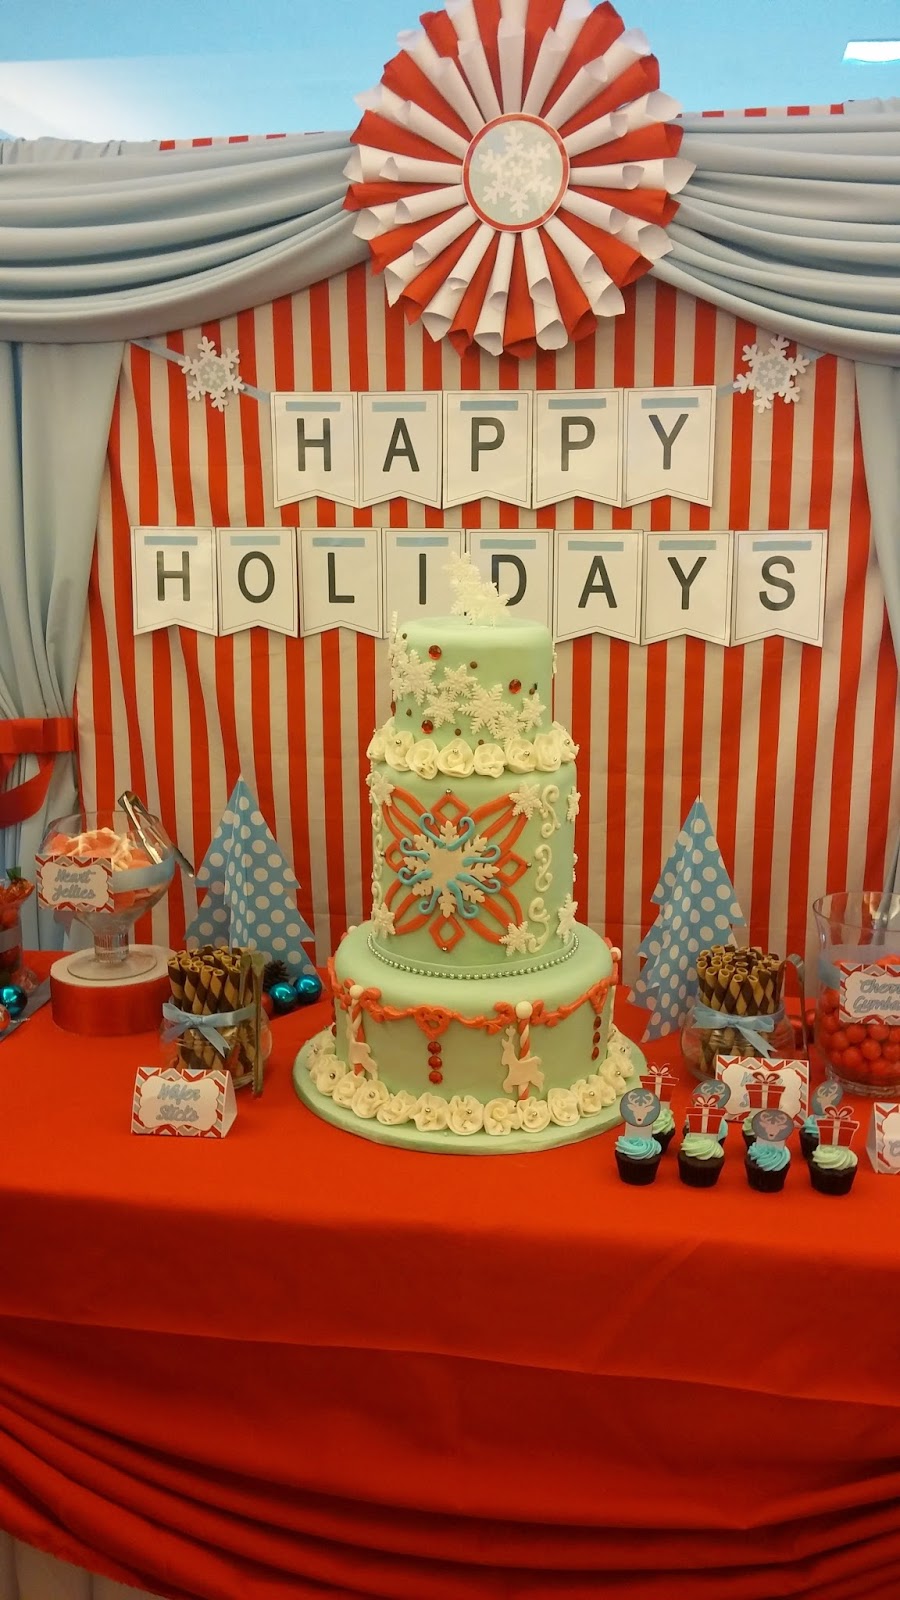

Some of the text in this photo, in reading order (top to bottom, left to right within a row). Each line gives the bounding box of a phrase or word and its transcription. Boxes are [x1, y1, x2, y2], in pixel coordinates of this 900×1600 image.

[296, 413, 690, 473] HAPPY
[156, 550, 795, 611] HOLIDAYS
[55, 869, 96, 883] Heart
[52, 884, 96, 901] Jellies
[157, 1083, 201, 1105] Wafer
[156, 1104, 199, 1122] Sticks
